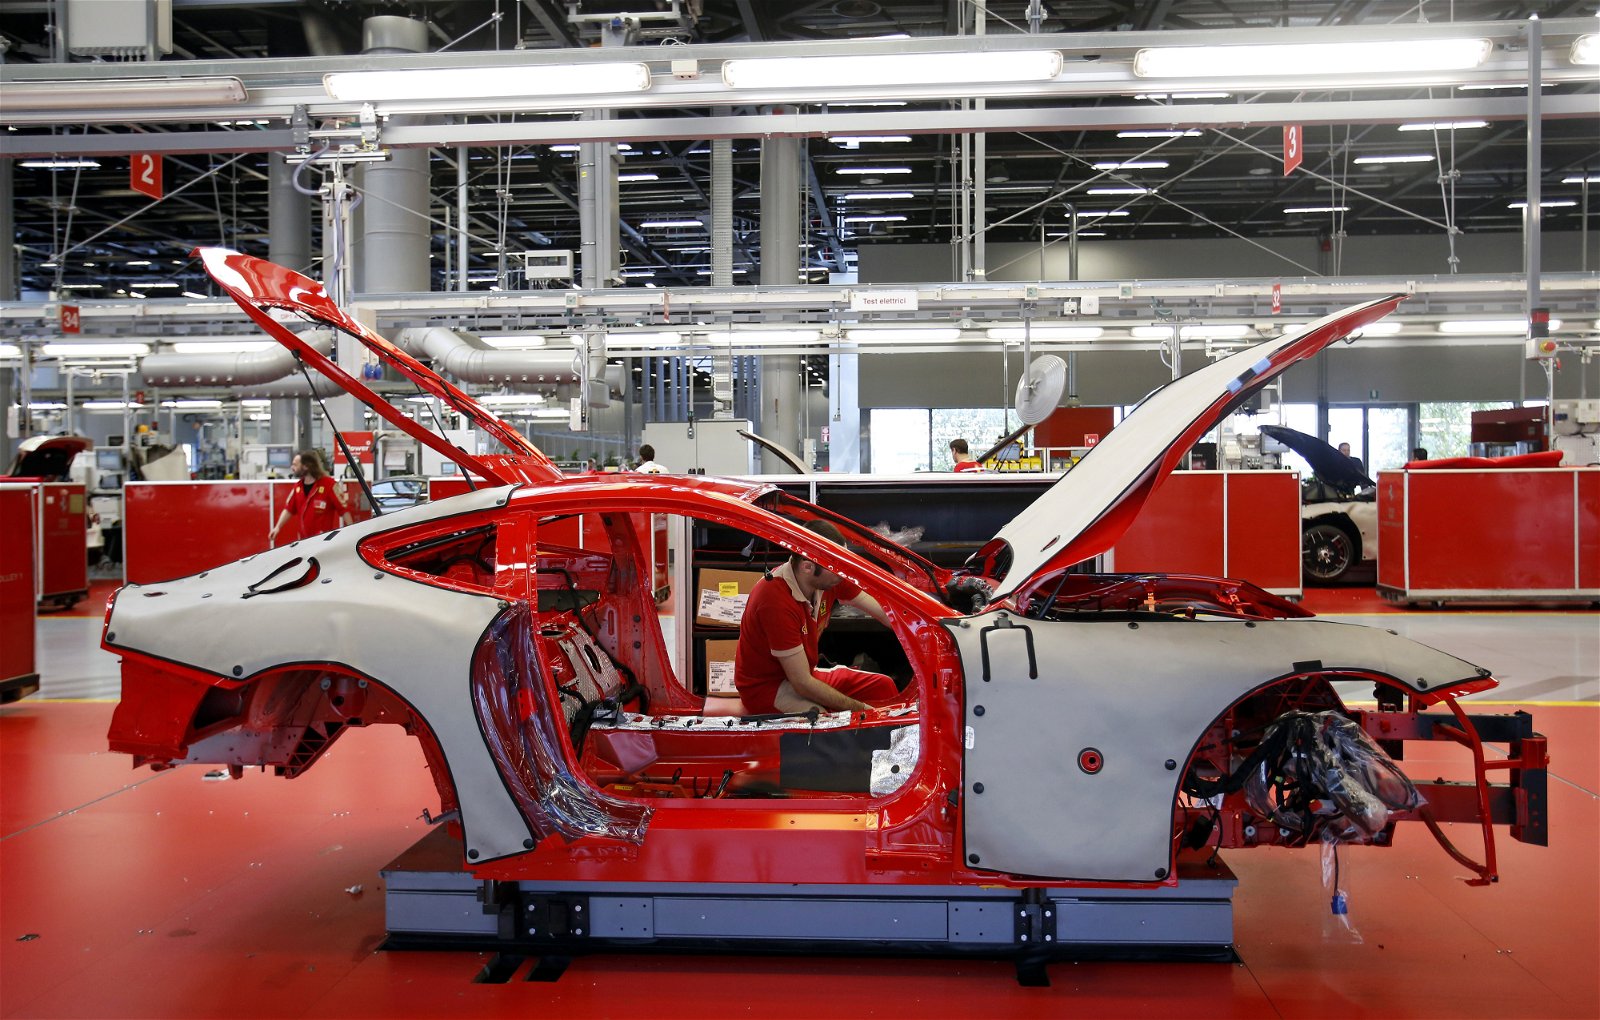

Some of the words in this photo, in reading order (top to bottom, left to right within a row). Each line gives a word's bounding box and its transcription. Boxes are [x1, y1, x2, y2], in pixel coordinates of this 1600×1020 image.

[1289, 126, 1297, 158] 3
[141, 154, 154, 185] 2
[1273, 290, 1280, 308] 32
[63, 311, 79, 328] 34
